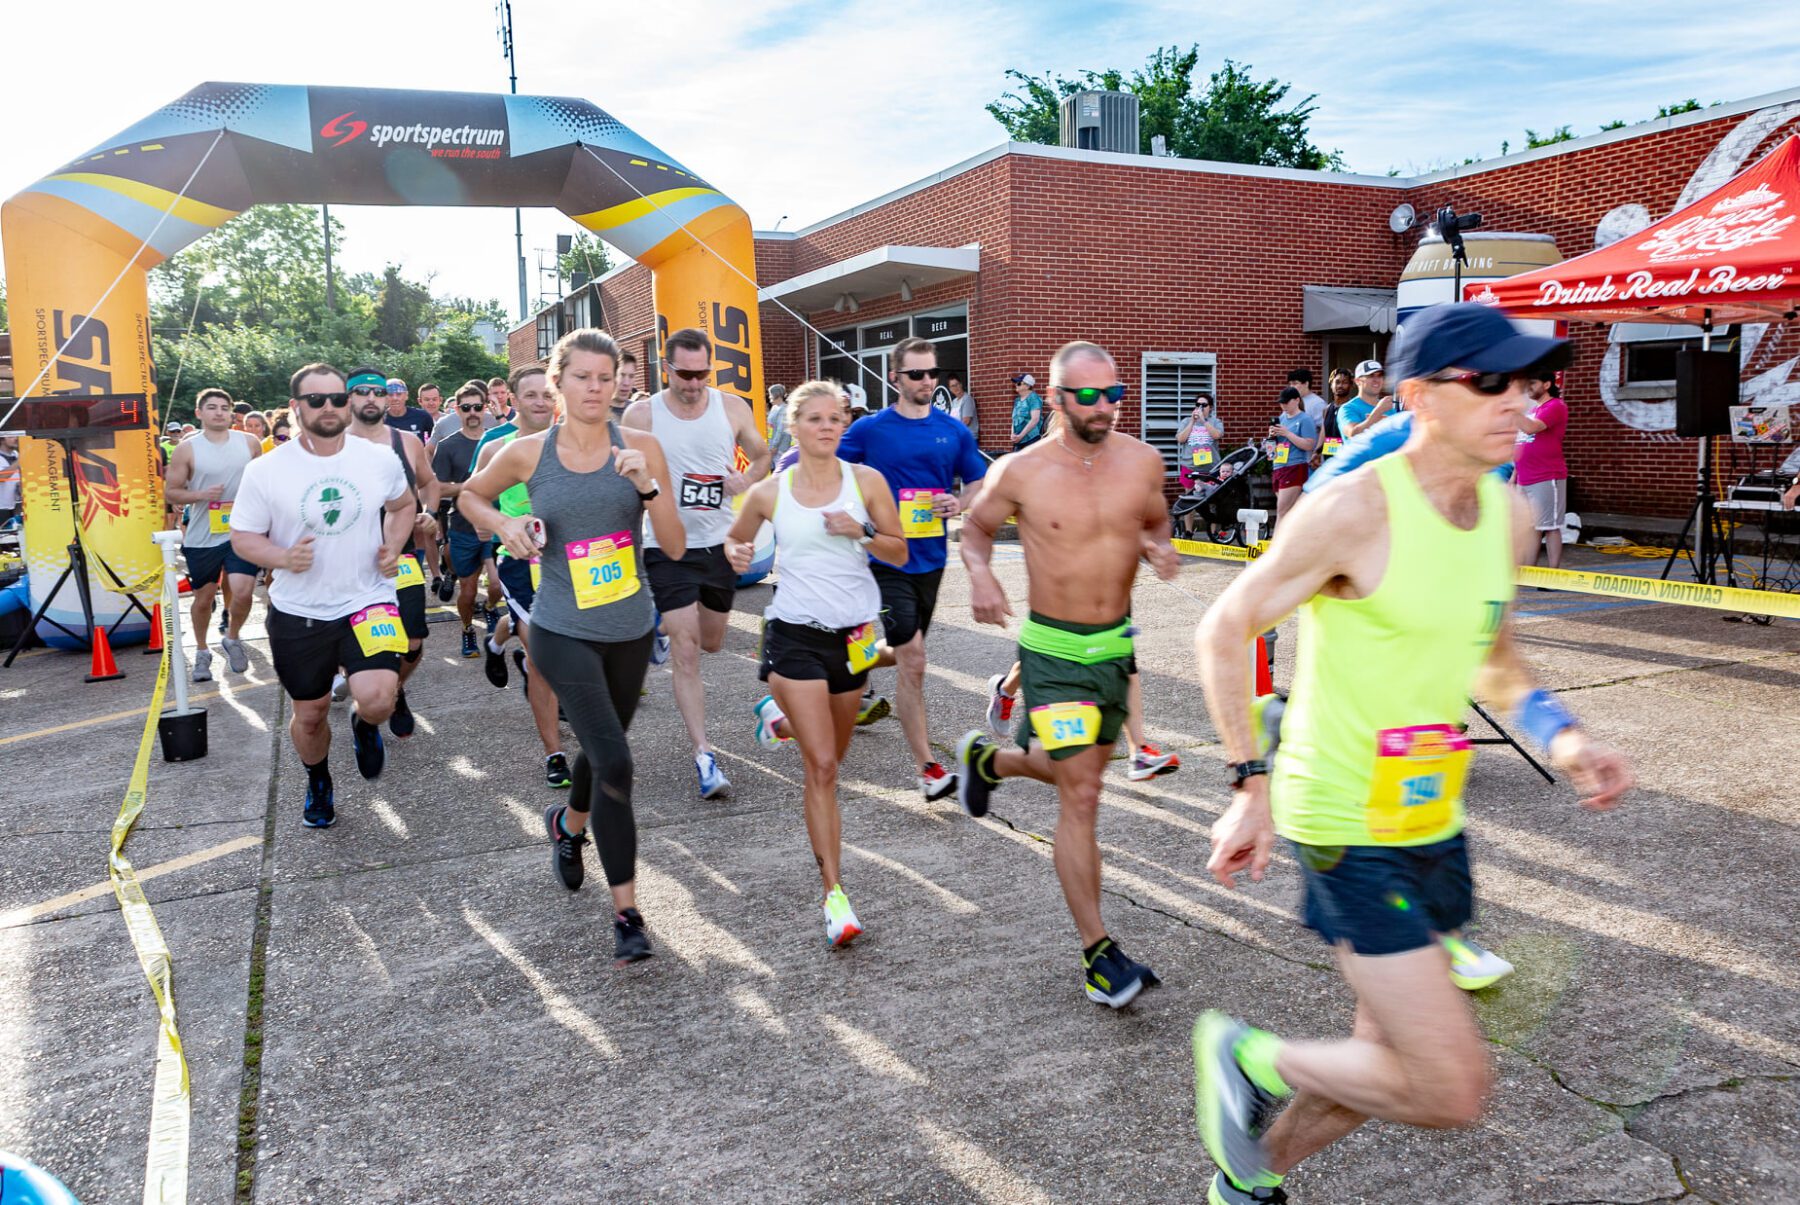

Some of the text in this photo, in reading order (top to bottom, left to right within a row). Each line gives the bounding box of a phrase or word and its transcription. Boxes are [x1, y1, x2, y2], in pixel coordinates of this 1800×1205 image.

[370, 123, 505, 149] sportspectrum
[431, 149, 443, 158] we
[461, 146, 476, 159] the
[476, 147, 501, 160] south
[1533, 275, 1617, 306] Drink
[1620, 268, 1701, 300] Real
[1698, 265, 1787, 294] Beer
[46, 438, 61, 513] ANAGEMENT
[683, 485, 722, 505] 545
[589, 561, 622, 586] 205
[370, 623, 397, 638] 400
